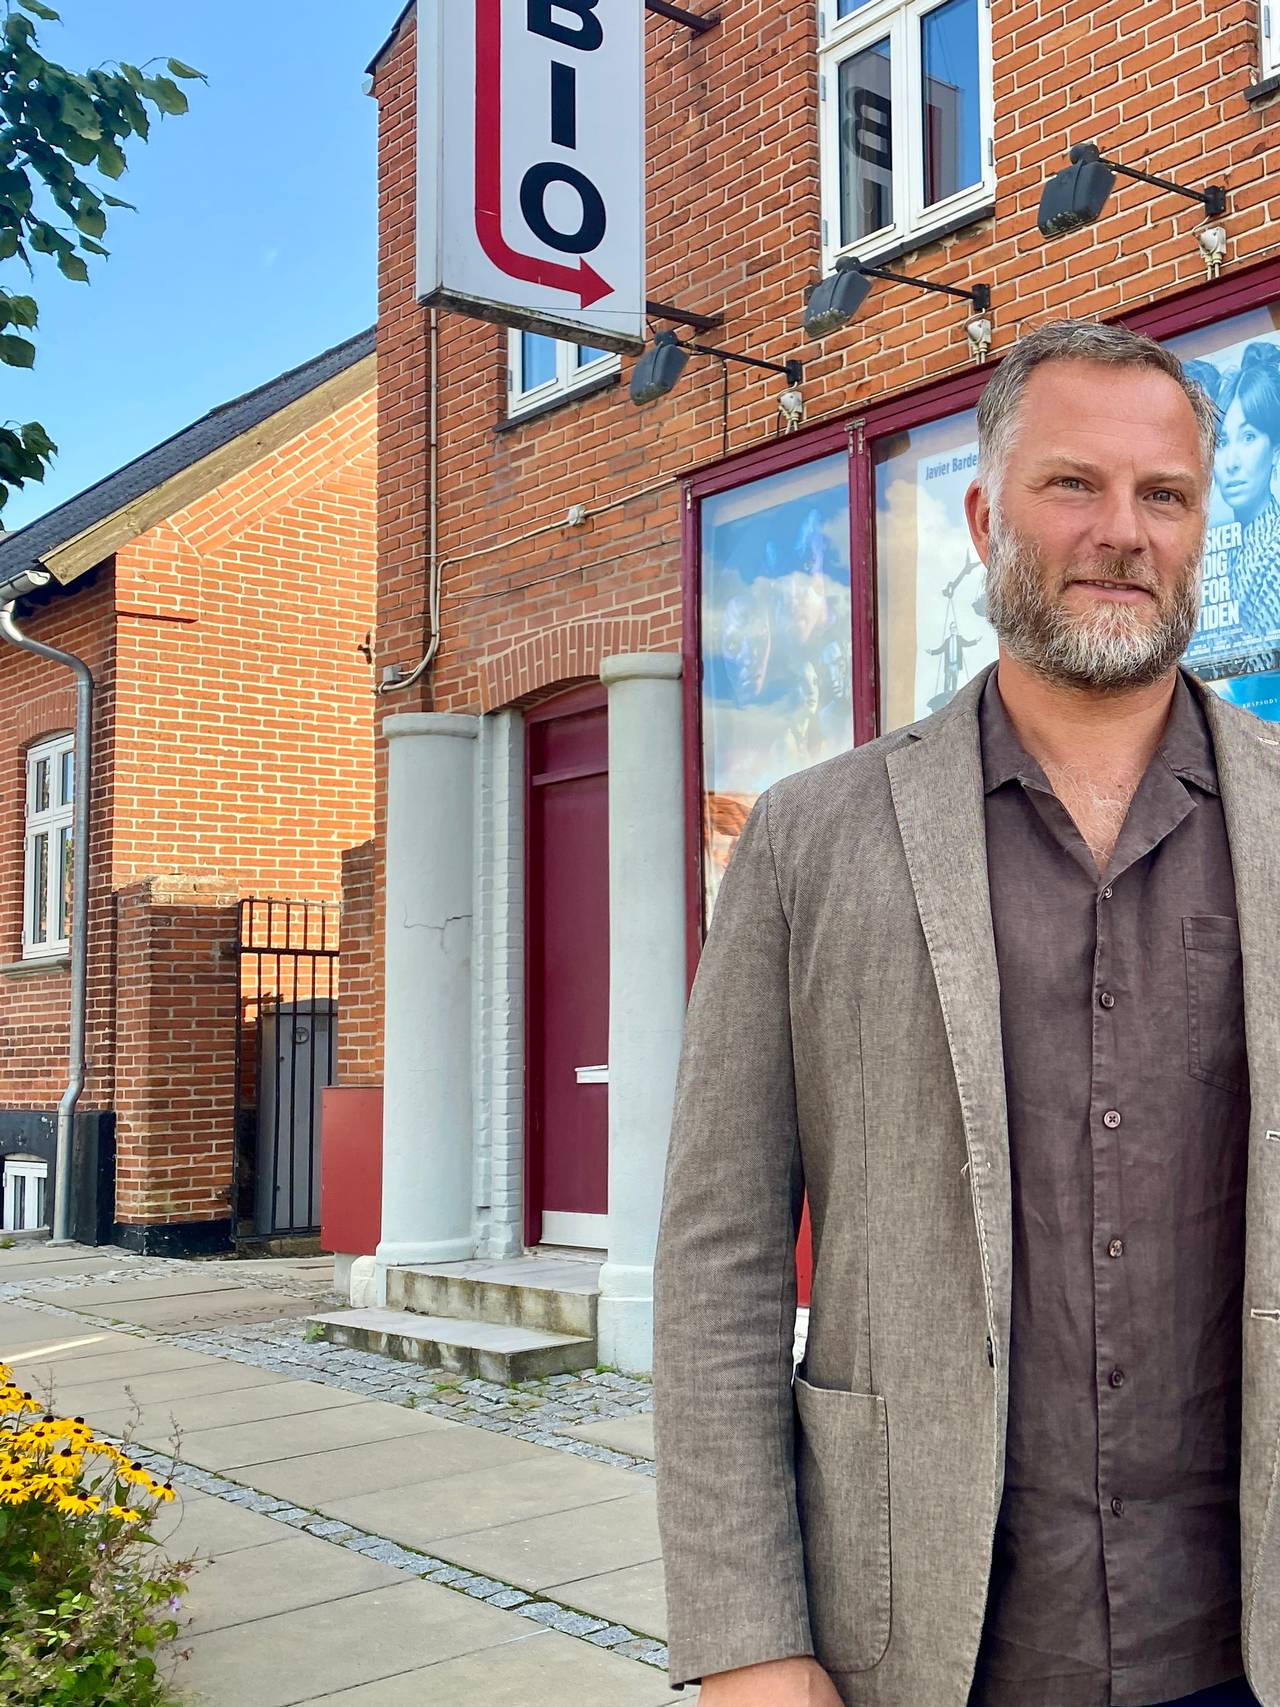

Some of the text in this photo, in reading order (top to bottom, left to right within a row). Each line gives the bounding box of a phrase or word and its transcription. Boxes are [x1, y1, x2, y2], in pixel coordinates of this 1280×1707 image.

[925, 453, 978, 480] Javier Barde
[1203, 522, 1243, 553] SKER
[1203, 550, 1229, 579] DIG
[1201, 576, 1231, 606] FOR
